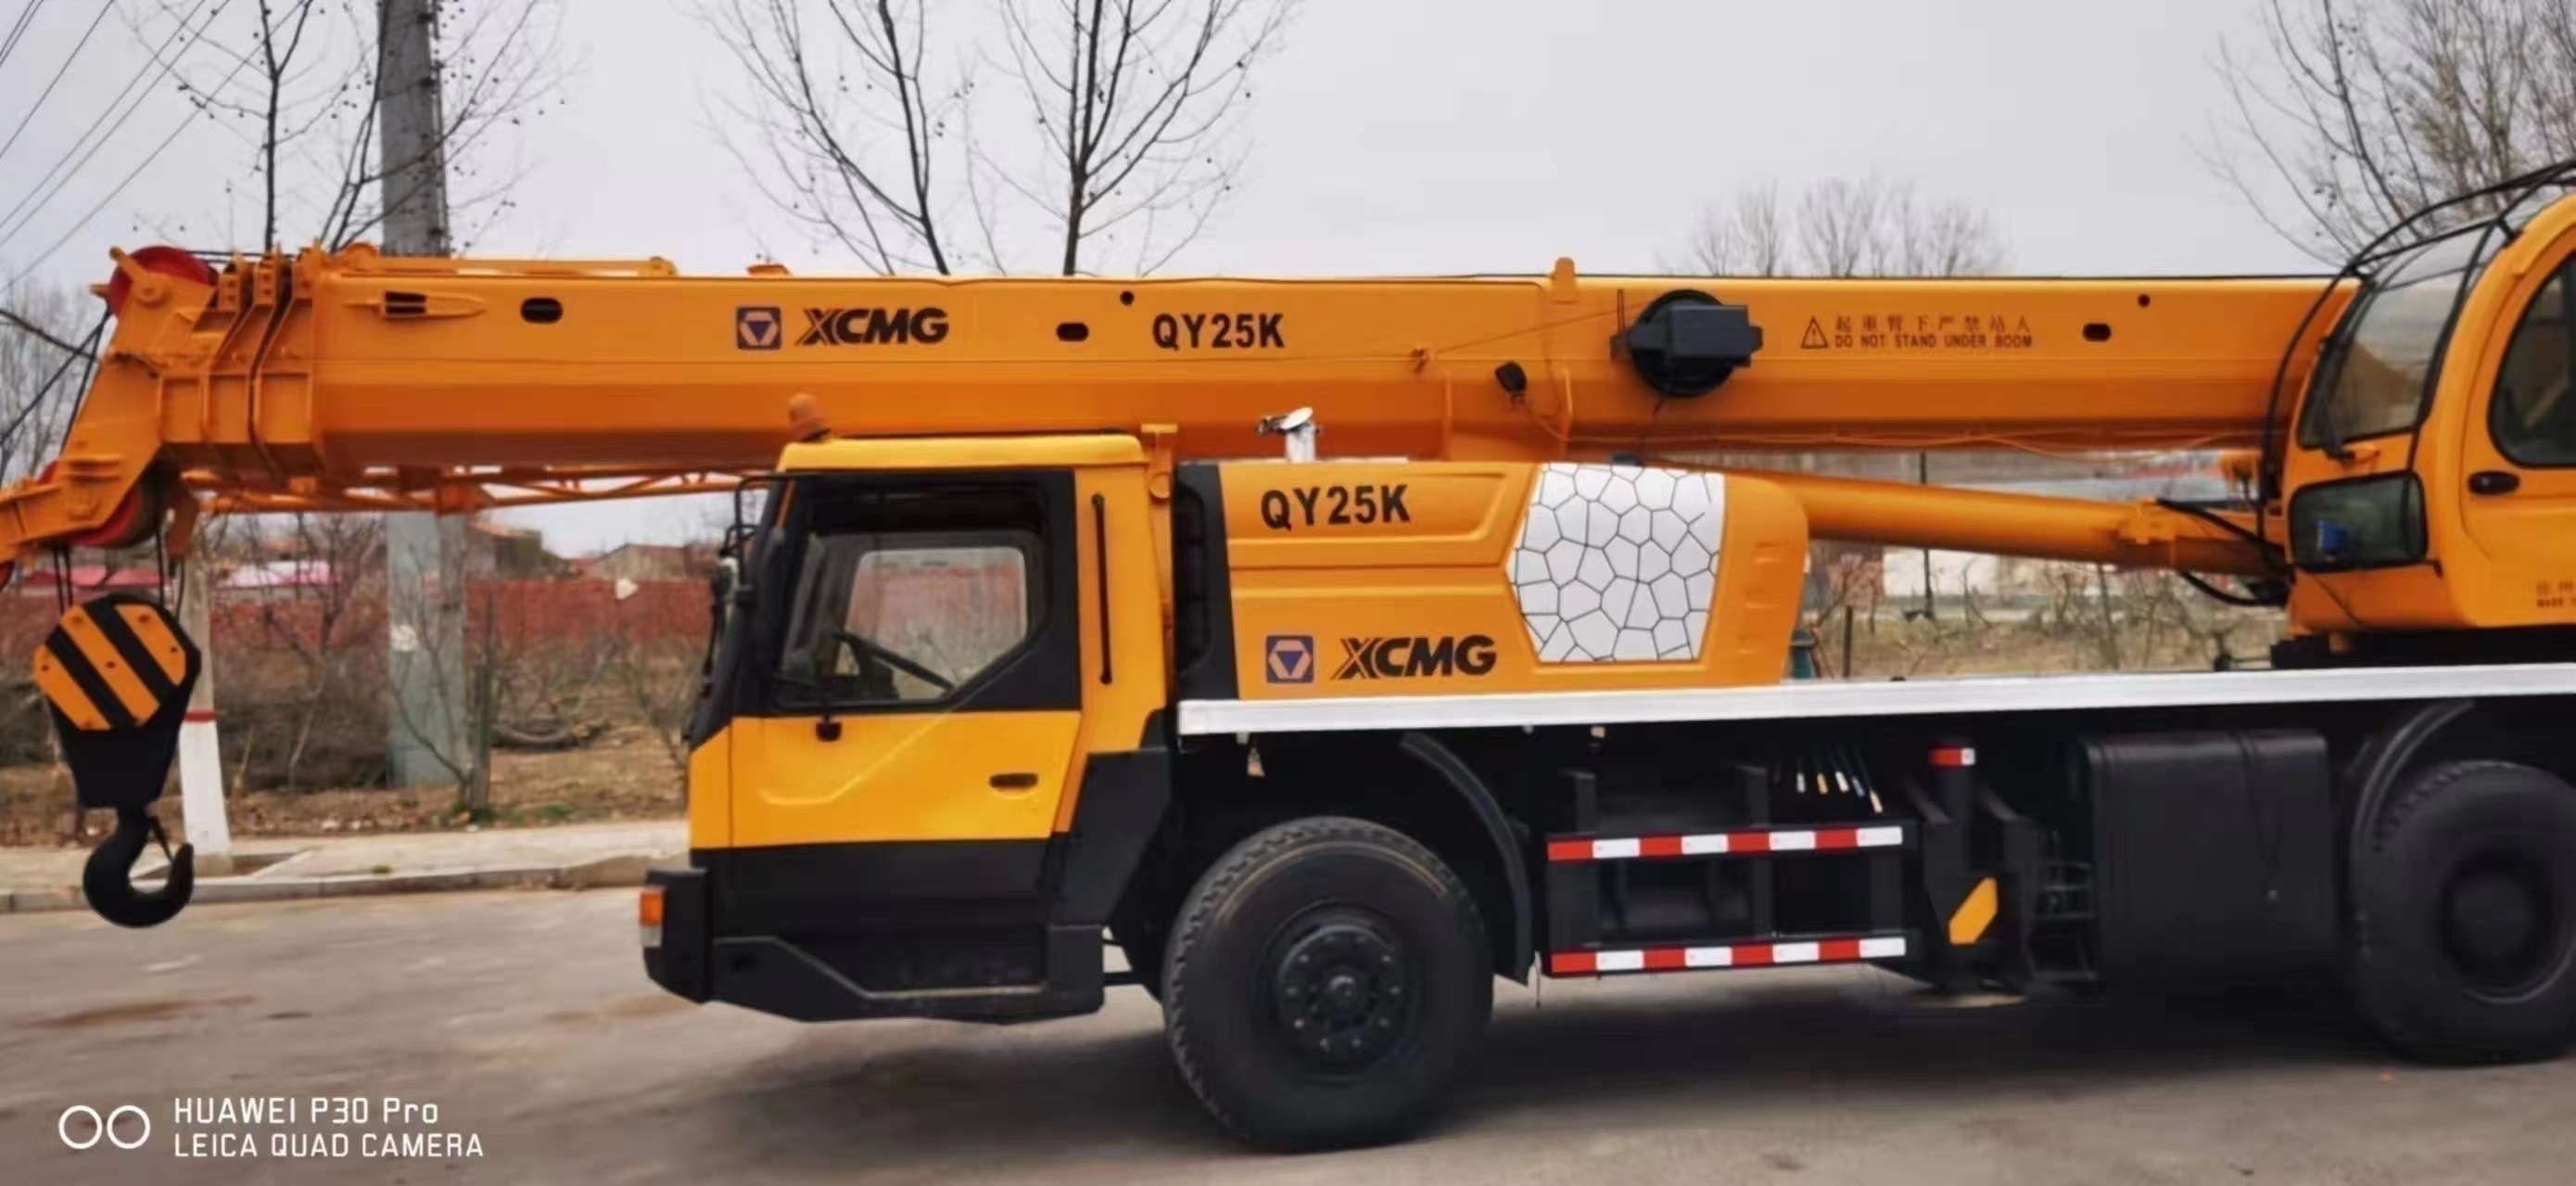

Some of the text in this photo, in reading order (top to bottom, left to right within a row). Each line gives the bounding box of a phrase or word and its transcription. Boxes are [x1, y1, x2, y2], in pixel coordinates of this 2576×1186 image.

[794, 307, 949, 345] XCMG
[1152, 313, 1286, 351] QY25K
[1834, 335, 2034, 349] DO NOT STAND UNDER BOOM
[1261, 484, 1411, 531] QY25K
[1330, 634, 1498, 681] XCMG
